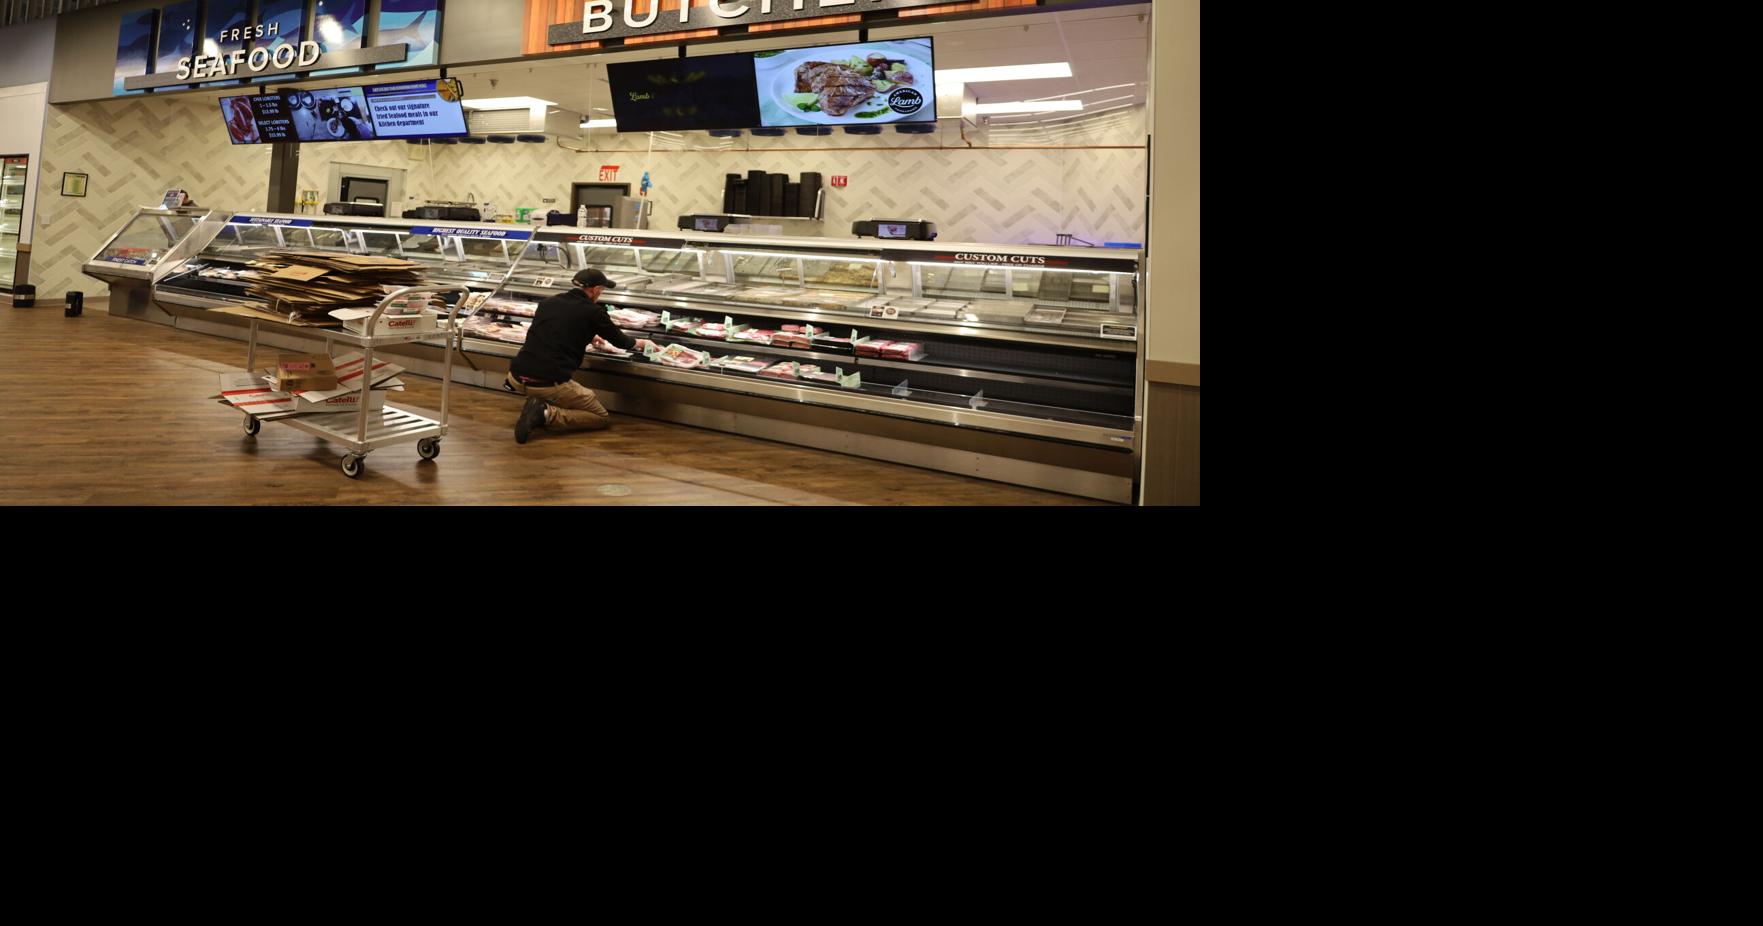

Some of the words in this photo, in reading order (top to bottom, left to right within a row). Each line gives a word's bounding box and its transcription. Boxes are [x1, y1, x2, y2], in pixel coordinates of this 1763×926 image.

[220, 22, 278, 42] FRESH
[176, 40, 321, 80] SEAFOOD
[629, 91, 650, 102] Lamb
[890, 96, 922, 106] Lamb
[406, 103, 430, 111] signature
[599, 169, 618, 182] EXIT
[954, 253, 1008, 262] CUSTOM
[1009, 255, 1046, 264] CUTS
